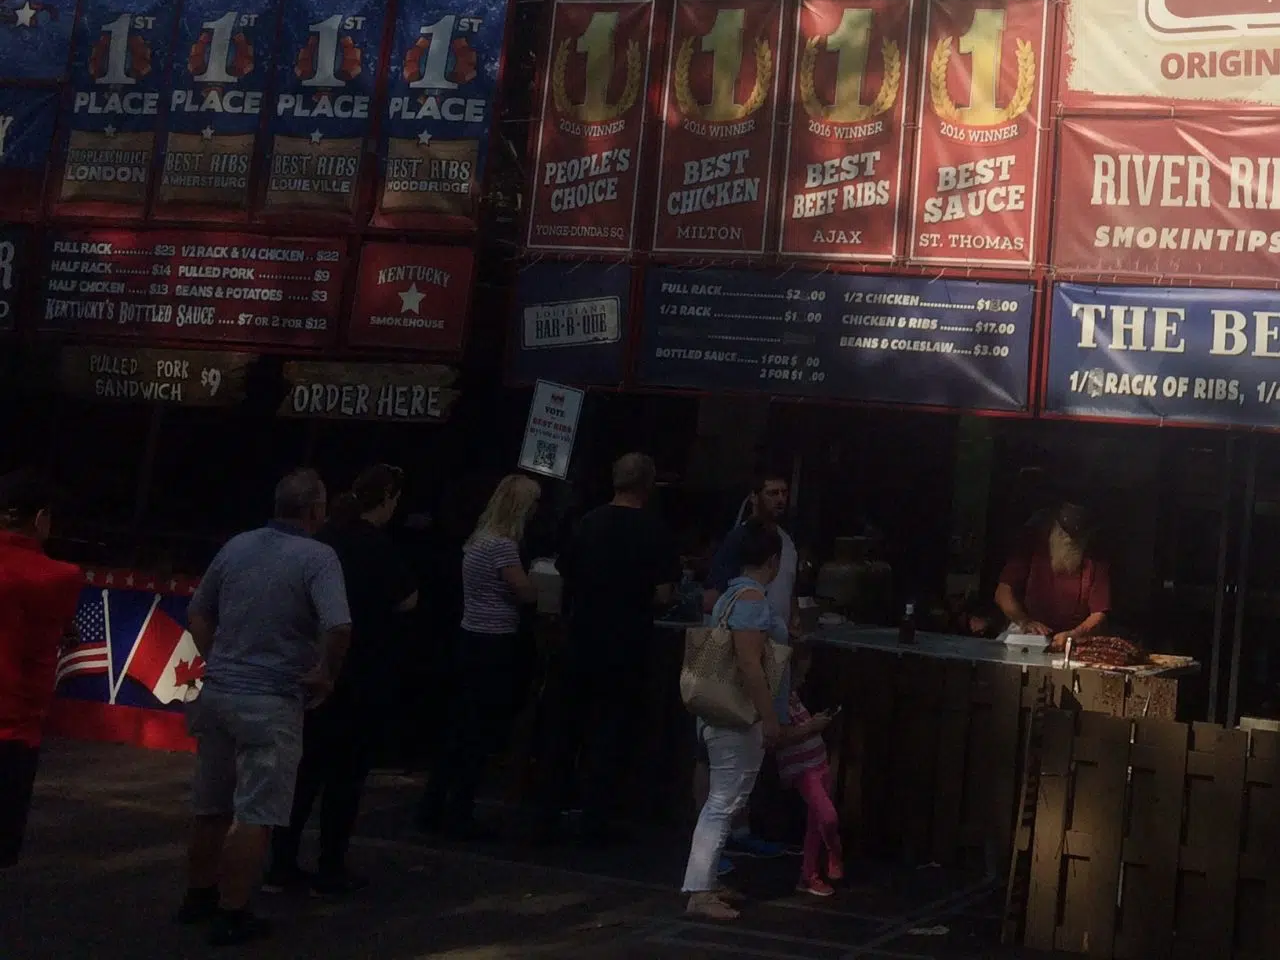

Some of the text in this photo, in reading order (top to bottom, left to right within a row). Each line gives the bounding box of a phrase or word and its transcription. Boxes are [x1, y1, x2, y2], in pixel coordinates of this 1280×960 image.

[66, 164, 145, 182] LONDON
[805, 151, 881, 188] BEST
[936, 155, 1015, 192] BEST
[1090, 153, 1212, 209] RIVER
[792, 180, 889, 220] BEEF RIBS
[922, 185, 1025, 224] SAUCE
[814, 228, 861, 244] AJAX
[919, 234, 1024, 251] ST. THOMAS
[178, 266, 329, 282] PULLED PORK $9
[378, 266, 451, 288] KENTUCKY
[370, 316, 444, 330] SMOKEHOUSE
[842, 315, 1015, 334] CHICKEN & RIBS $17.00
[1072, 304, 1187, 354] THE
[890, 338, 1009, 356] COLESLAW $3.00
[96, 379, 182, 400] SANDWICH
[157, 360, 221, 396] PORK $9
[1105, 373, 1157, 398] RACK
[1163, 375, 1189, 398] OF
[1194, 376, 1245, 403] RIBS,
[292, 385, 441, 417] ORDER HERE
